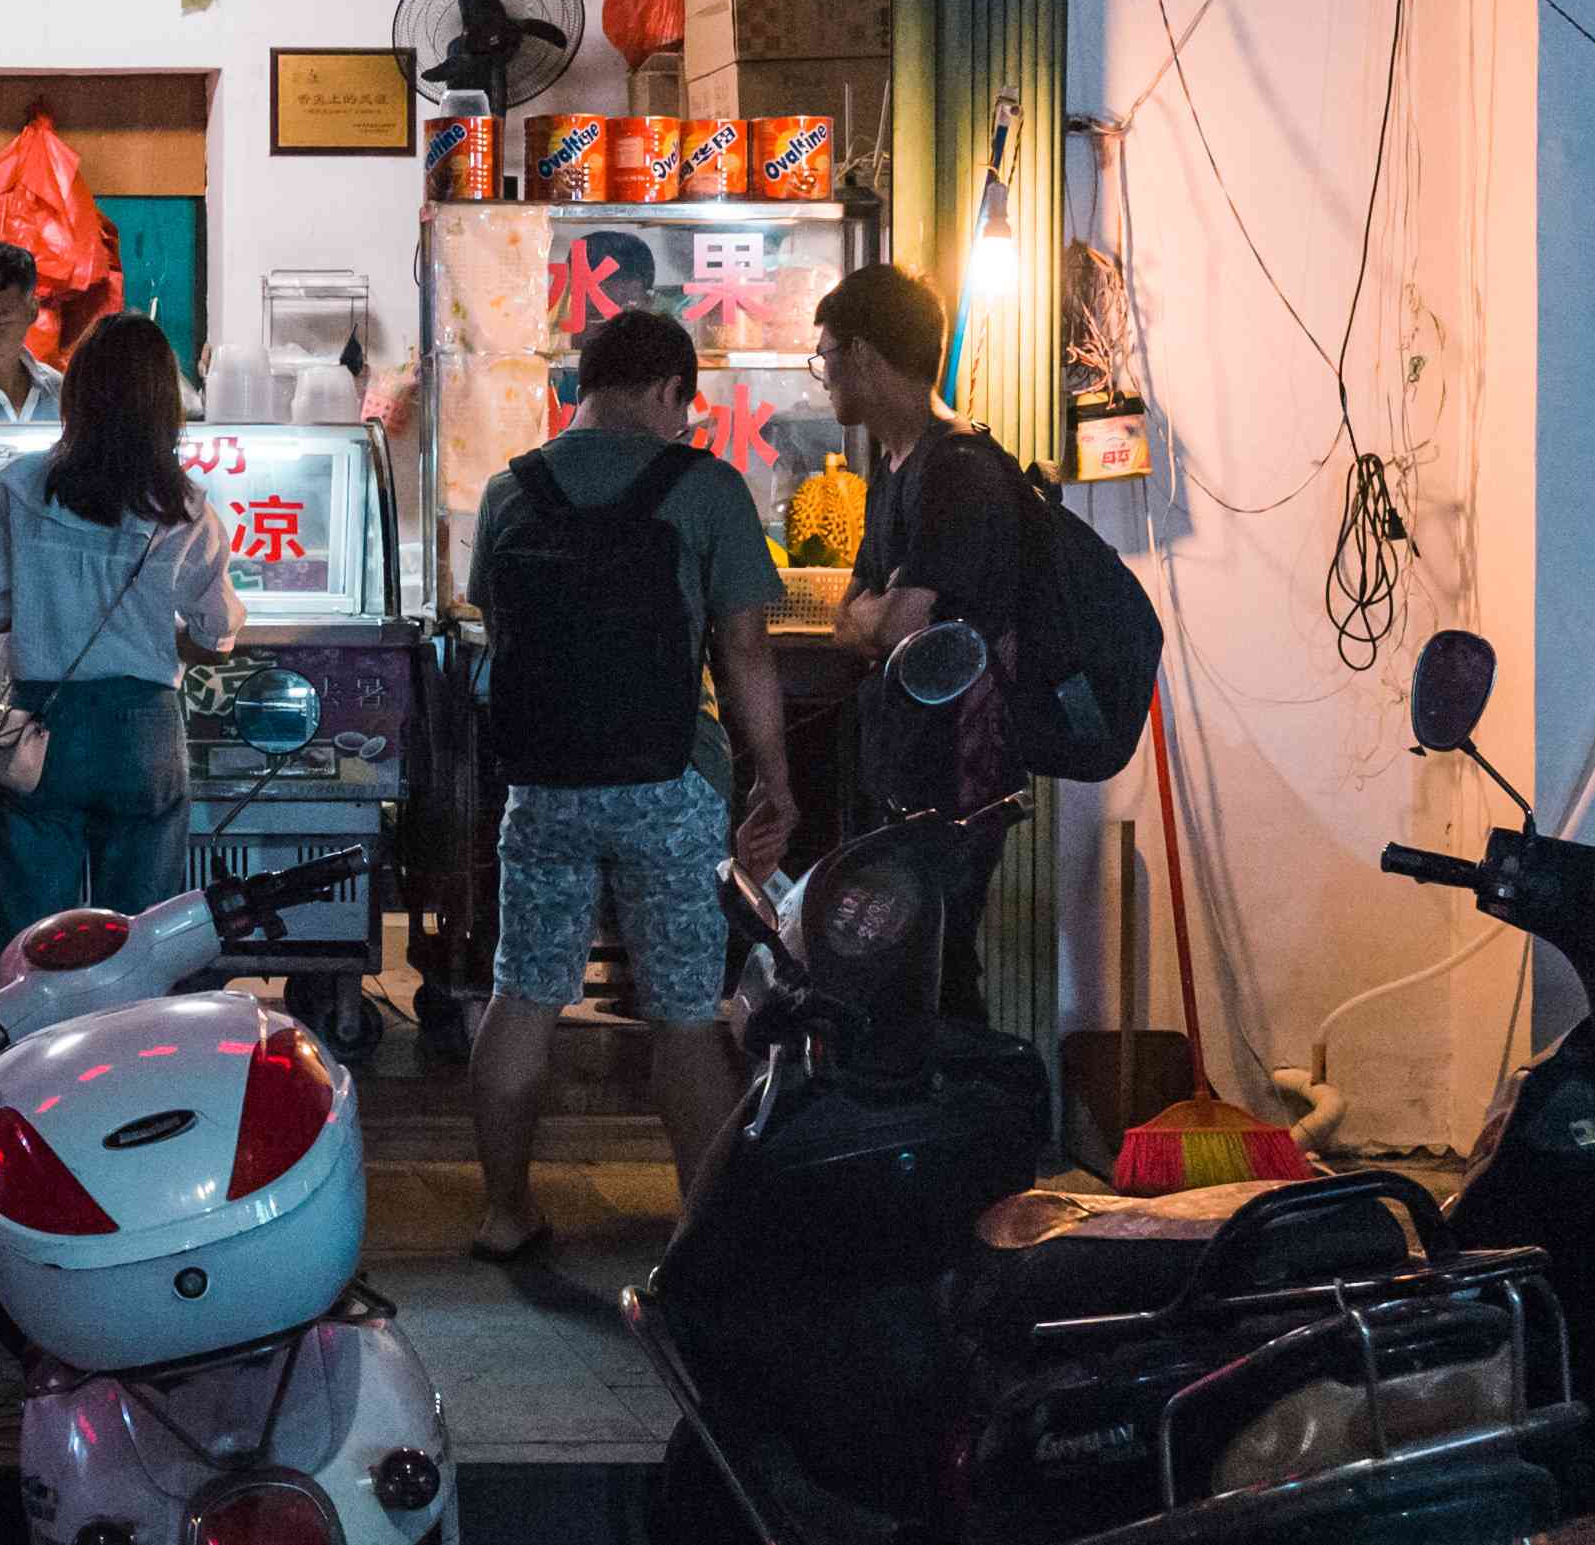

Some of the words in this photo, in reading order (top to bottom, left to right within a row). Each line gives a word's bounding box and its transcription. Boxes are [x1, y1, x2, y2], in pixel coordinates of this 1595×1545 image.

[537, 121, 600, 179] Ovaltine
[763, 123, 828, 180] Ovaltine
[547, 232, 777, 334] 水果
[229, 494, 307, 564] 凉
